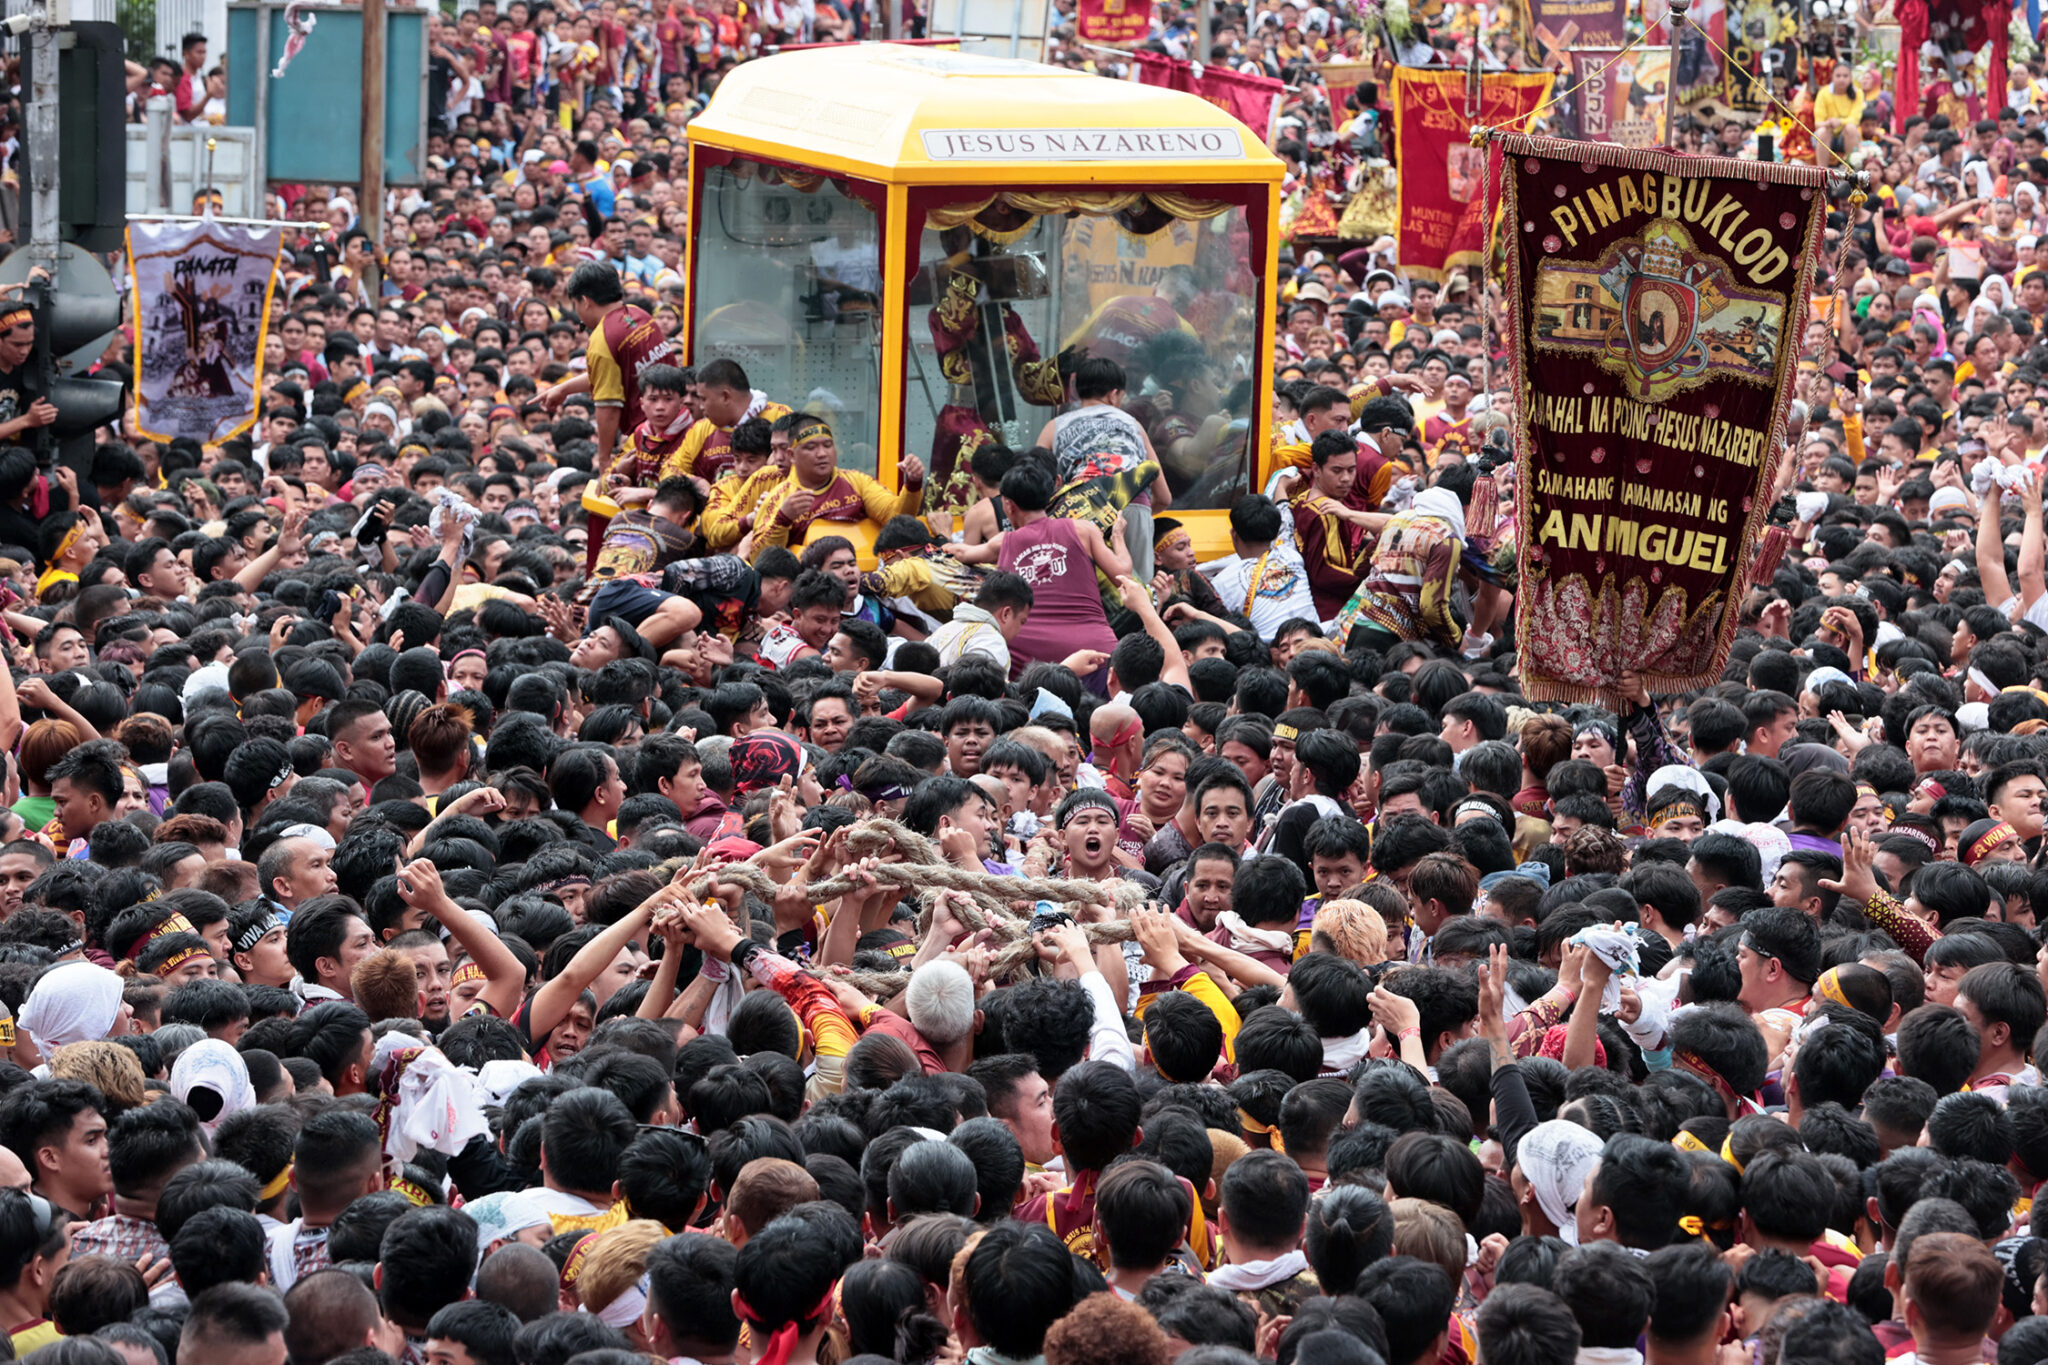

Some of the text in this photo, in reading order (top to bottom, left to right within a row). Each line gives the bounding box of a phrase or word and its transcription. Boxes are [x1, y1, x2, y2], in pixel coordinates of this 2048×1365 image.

[944, 132, 1223, 157] JESUS NAZARENO
[1551, 172, 1789, 284] PINAGBUKLOD
[174, 255, 239, 277] PANATA
[1589, 395, 1609, 433] NA
[1653, 406, 1701, 452] HESUS
[1537, 469, 1615, 501] SAMAHANG
[1707, 497, 1728, 524] NG
[1606, 515, 1728, 575] MIGUEL
[1895, 826, 1930, 844] NAZARENO
[1983, 827, 2006, 847] VIVA
[237, 922, 265, 950] VIVA
